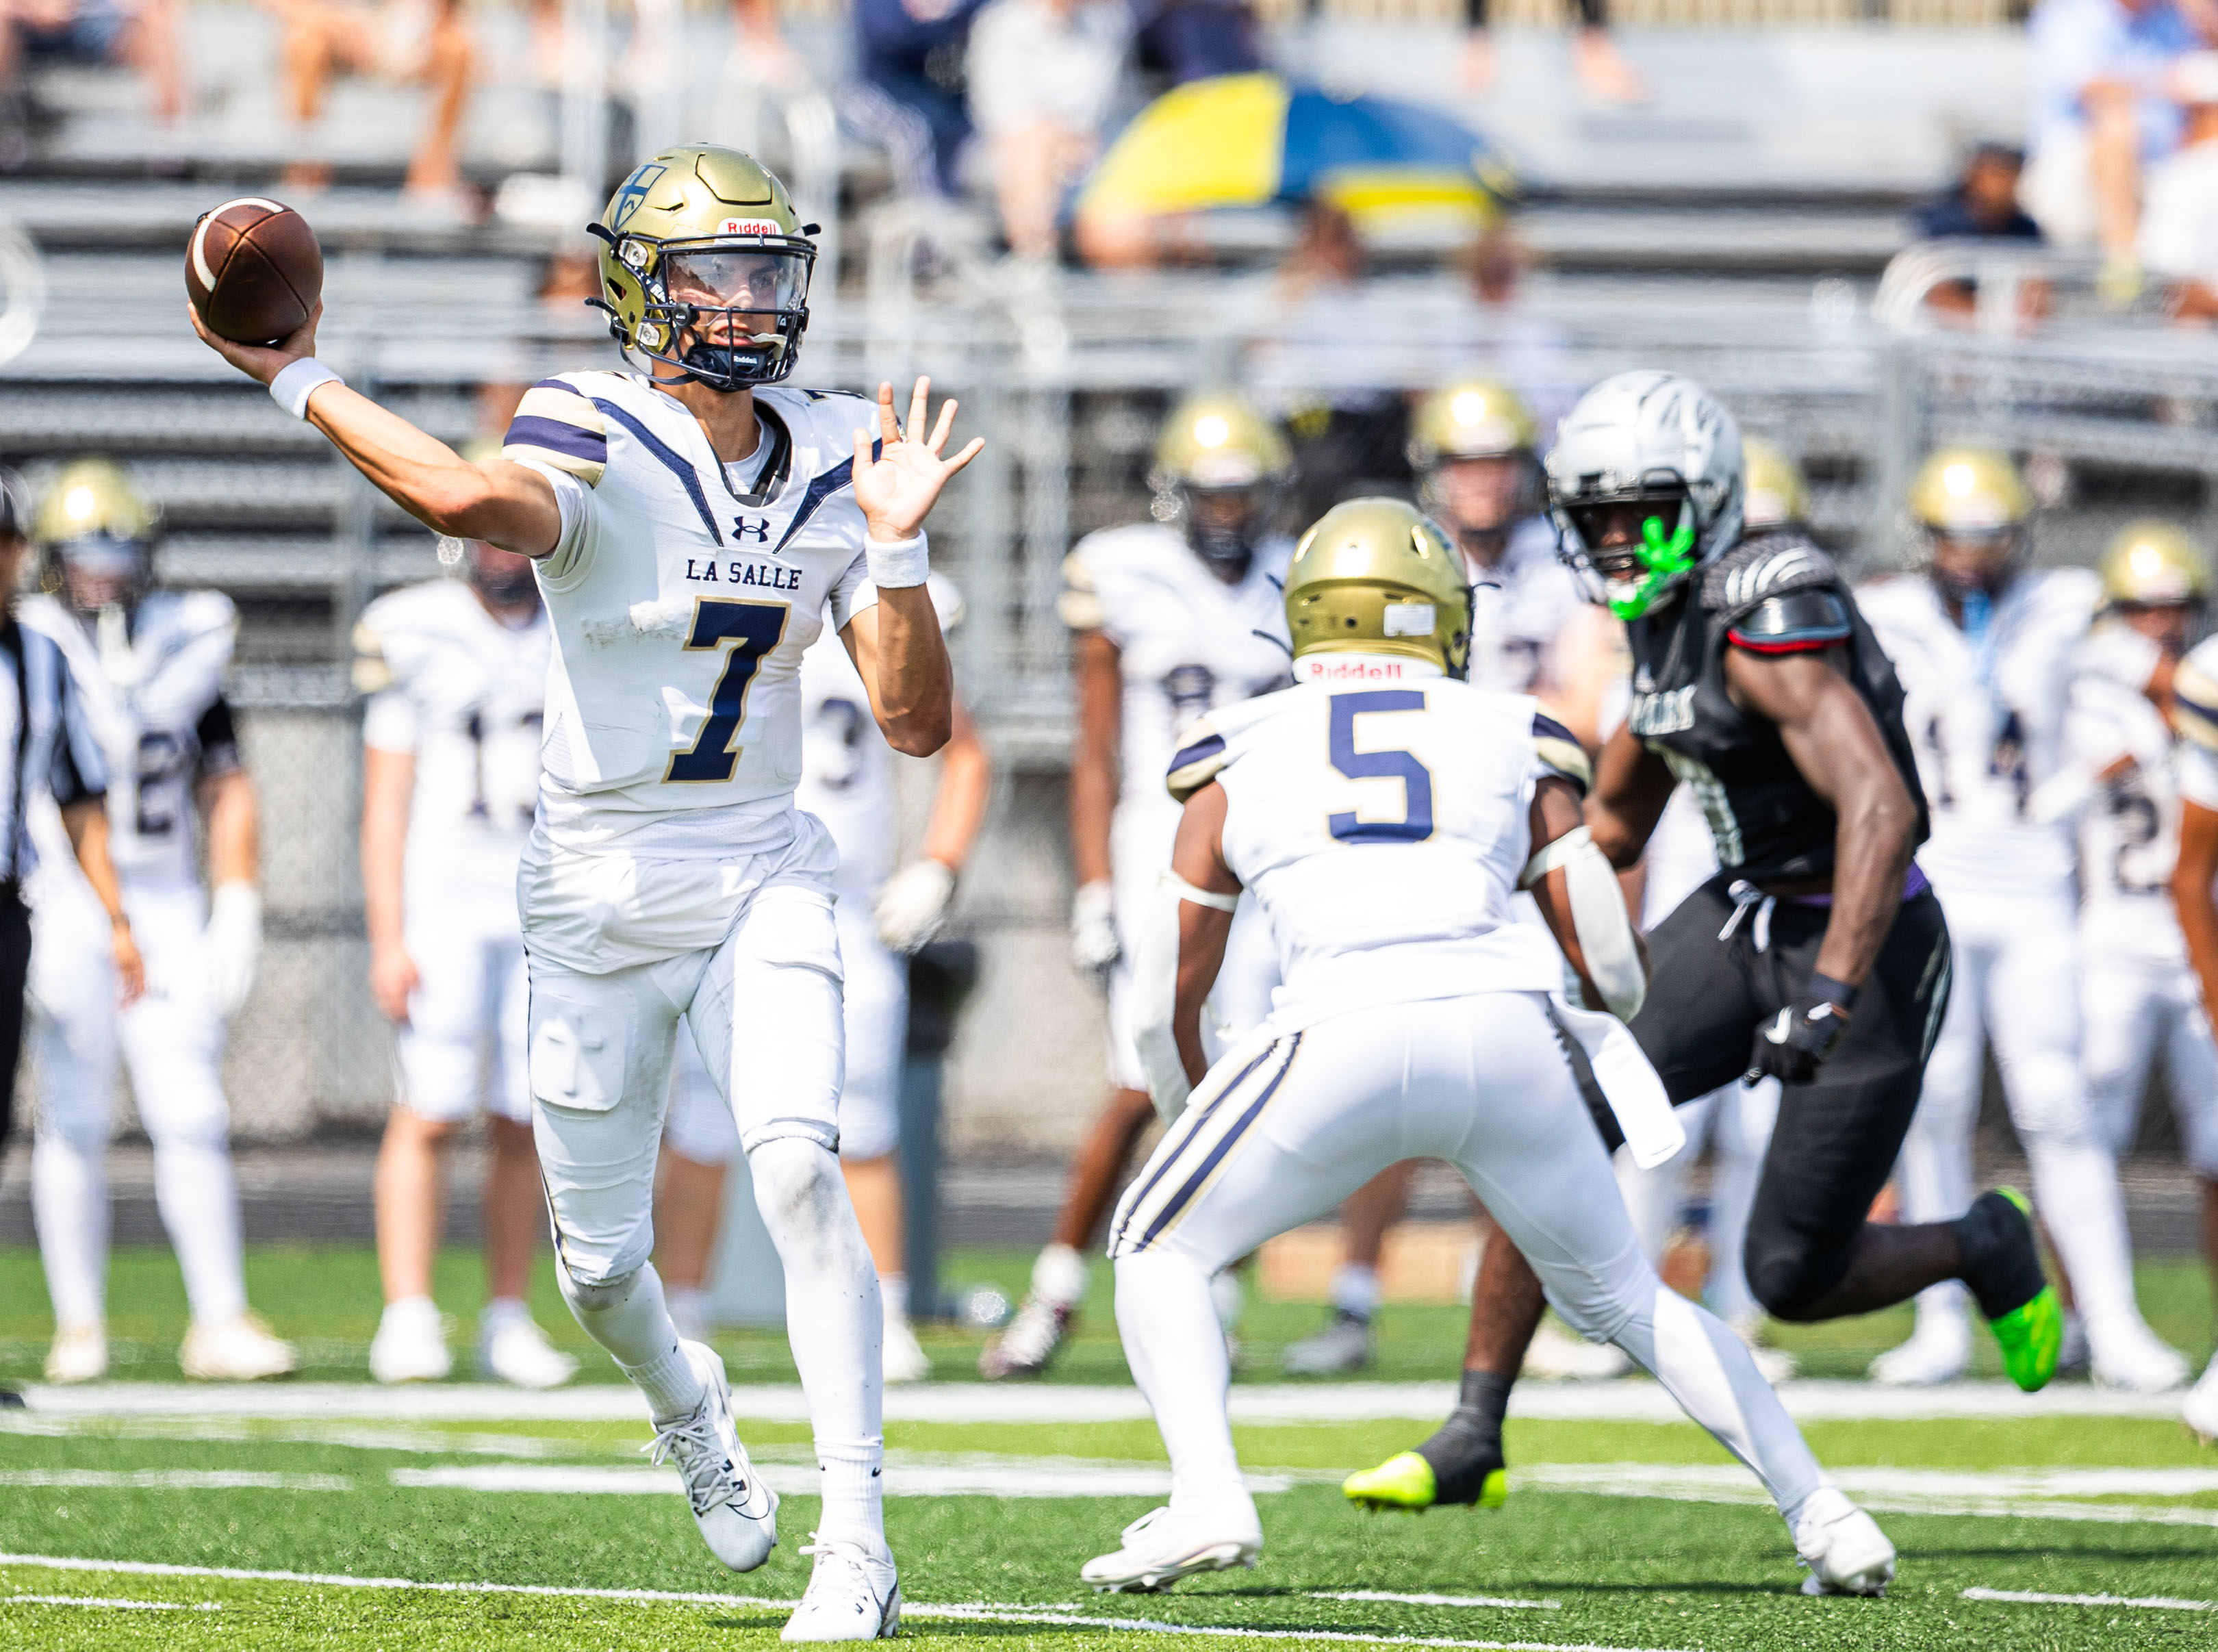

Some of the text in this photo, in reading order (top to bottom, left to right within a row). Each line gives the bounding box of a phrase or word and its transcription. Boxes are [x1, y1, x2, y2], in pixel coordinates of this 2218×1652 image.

[728, 223, 776, 234] Riddell
[686, 559, 803, 590] LA SALLE
[661, 594, 792, 785] 7
[1310, 663, 1403, 680] Riddell
[1326, 689, 1437, 845] 5
[1927, 711, 2028, 817] 14
